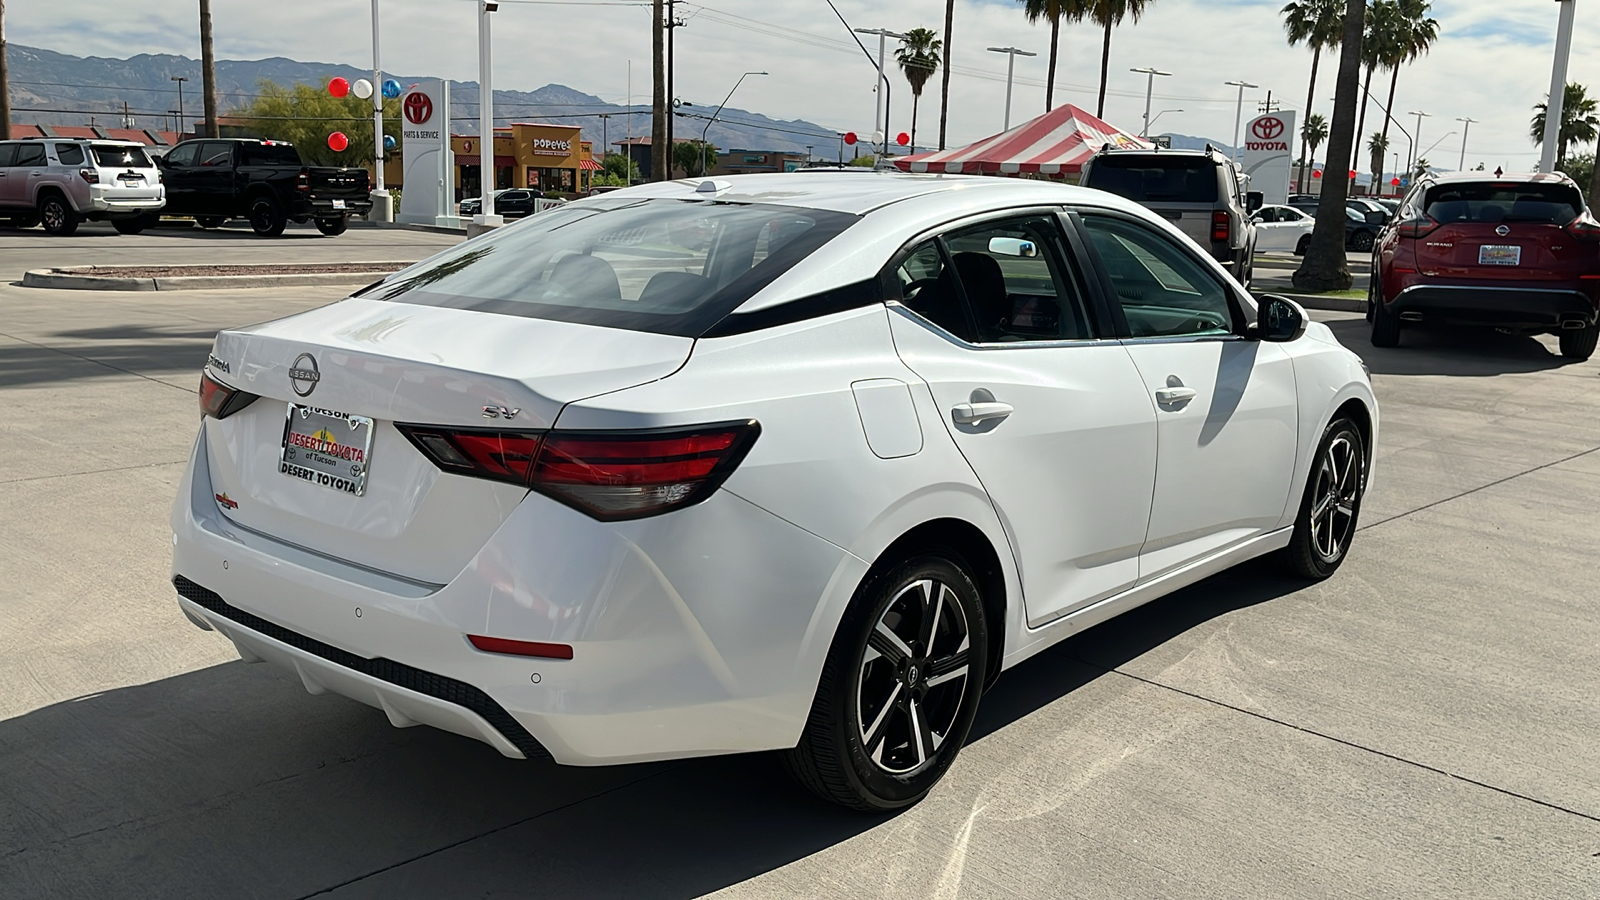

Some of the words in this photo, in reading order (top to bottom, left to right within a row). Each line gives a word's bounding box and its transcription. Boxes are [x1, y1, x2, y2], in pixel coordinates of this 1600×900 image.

[403, 130, 415, 138] PARTS
[420, 131, 439, 139] SERVICE
[1246, 141, 1288, 151] TOYOTA
[289, 369, 319, 381] NISSAN
[482, 405, 522, 420] SV
[289, 432, 323, 452] DESERT
[325, 441, 364, 463] TOYOTA
[305, 451, 313, 460] of
[313, 453, 337, 467] Tucson
[281, 462, 314, 481] DESERT
[317, 471, 356, 494] TOYOTA
